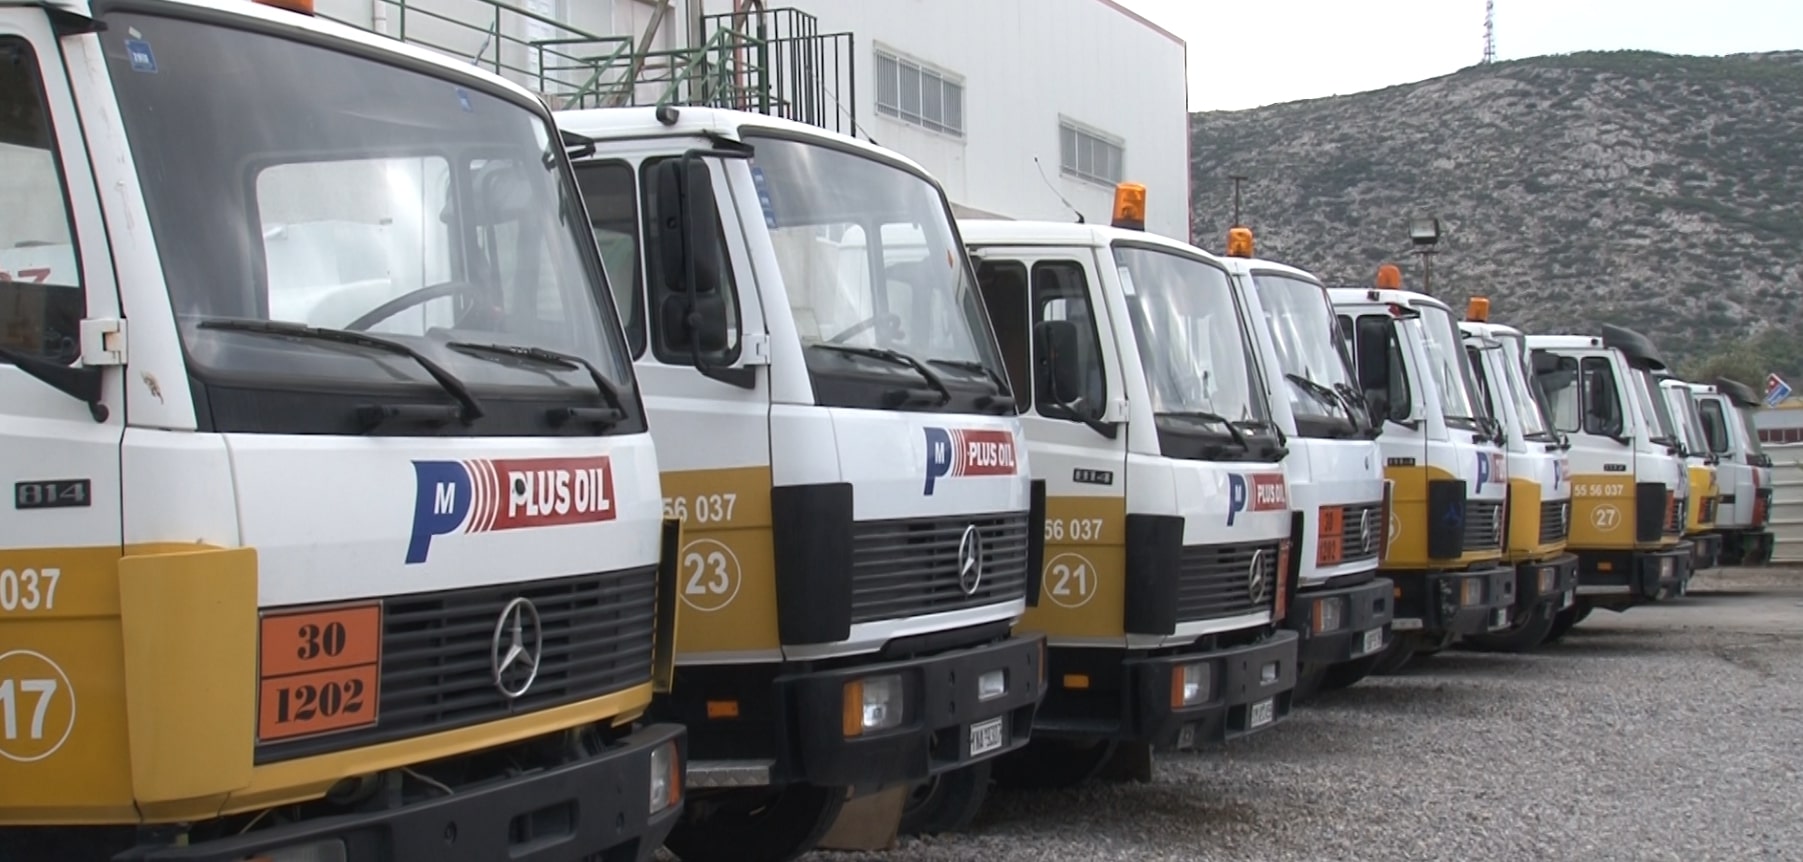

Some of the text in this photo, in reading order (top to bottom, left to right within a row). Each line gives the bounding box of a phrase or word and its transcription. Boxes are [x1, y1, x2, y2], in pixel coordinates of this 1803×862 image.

[968, 441, 997, 467] PLUS
[998, 443, 1014, 467] OIL
[18, 483, 86, 505] 814
[508, 470, 571, 518] PLUS
[575, 468, 610, 514] OIL
[1257, 483, 1275, 505] PLUS
[1574, 484, 1587, 496] 55
[1604, 484, 1624, 496] 037
[696, 493, 737, 523] 037
[1596, 508, 1616, 526] 27
[1070, 518, 1103, 540] 037
[684, 551, 729, 595] 23
[1052, 563, 1087, 595] 21
[0, 568, 61, 611] 037
[297, 621, 347, 661] 30
[0, 678, 58, 739] 17
[275, 678, 364, 724] 1202
